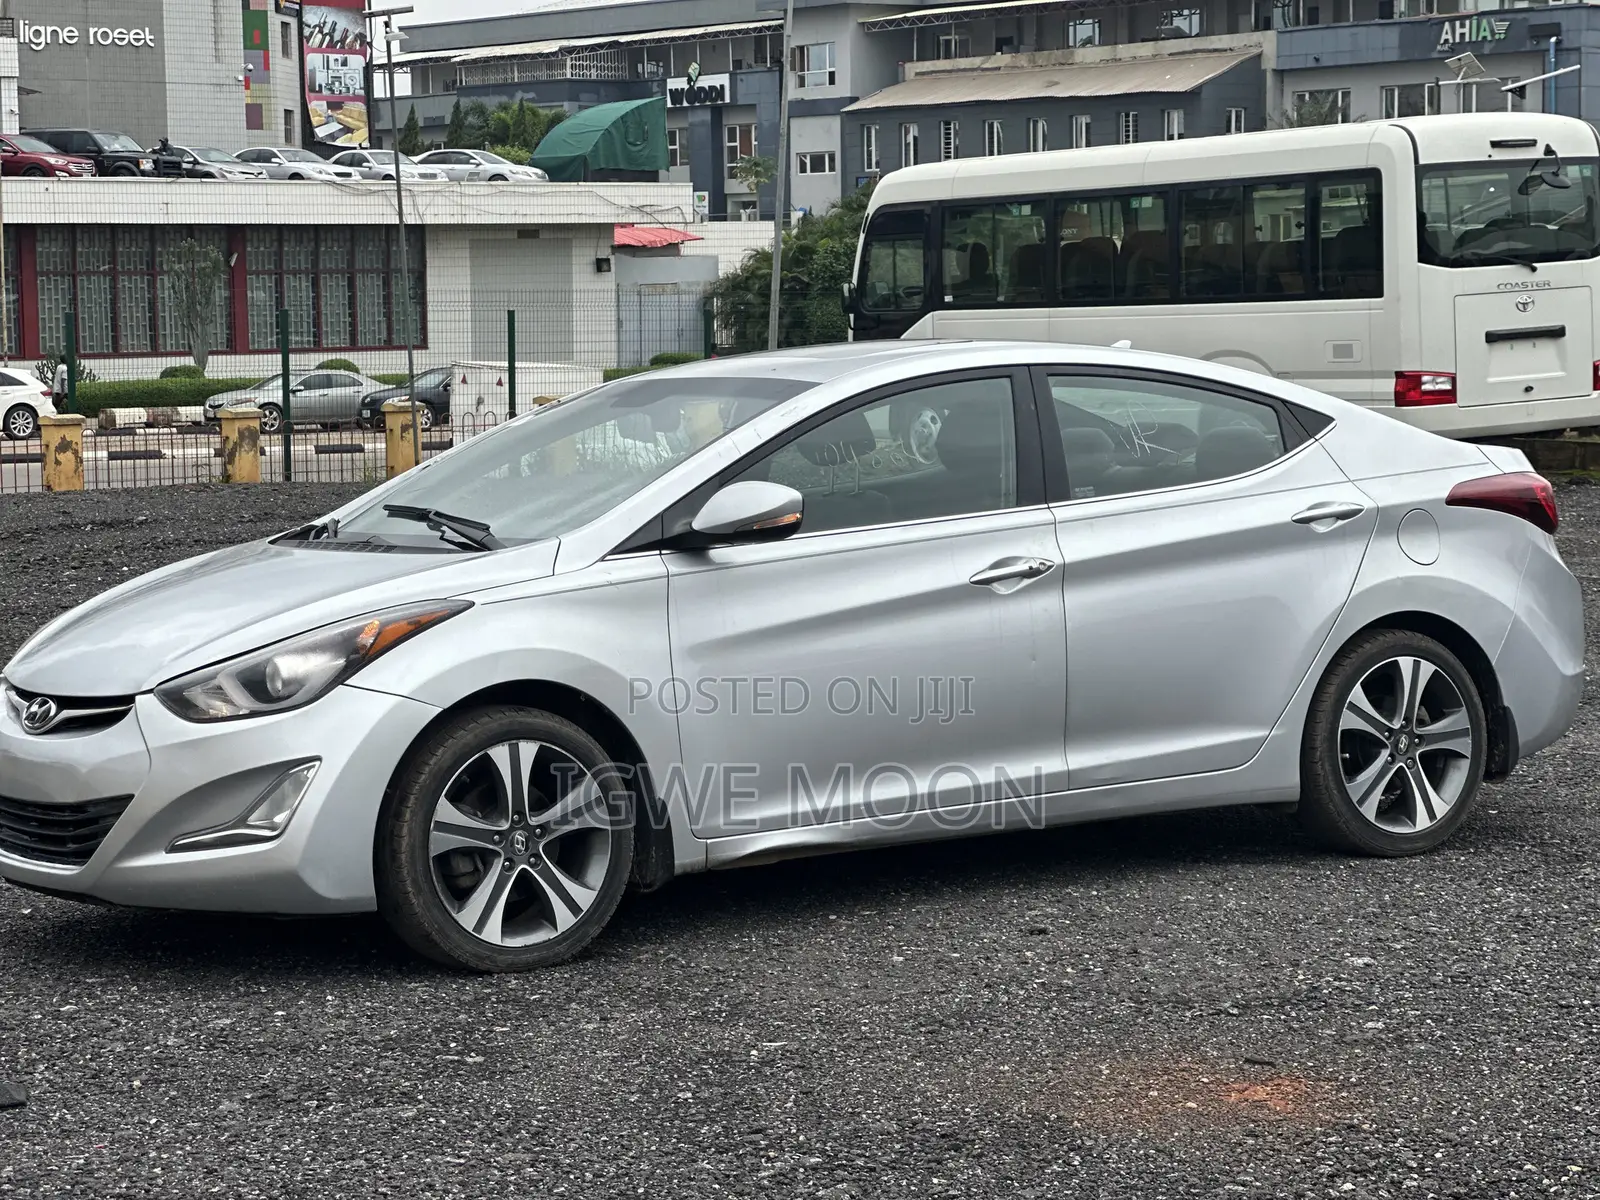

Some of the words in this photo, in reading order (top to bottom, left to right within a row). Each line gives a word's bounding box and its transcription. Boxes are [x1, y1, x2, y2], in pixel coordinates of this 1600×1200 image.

[19, 20, 79, 50] ligne
[89, 27, 155, 48] roset
[1497, 280, 1551, 290] COASTER
